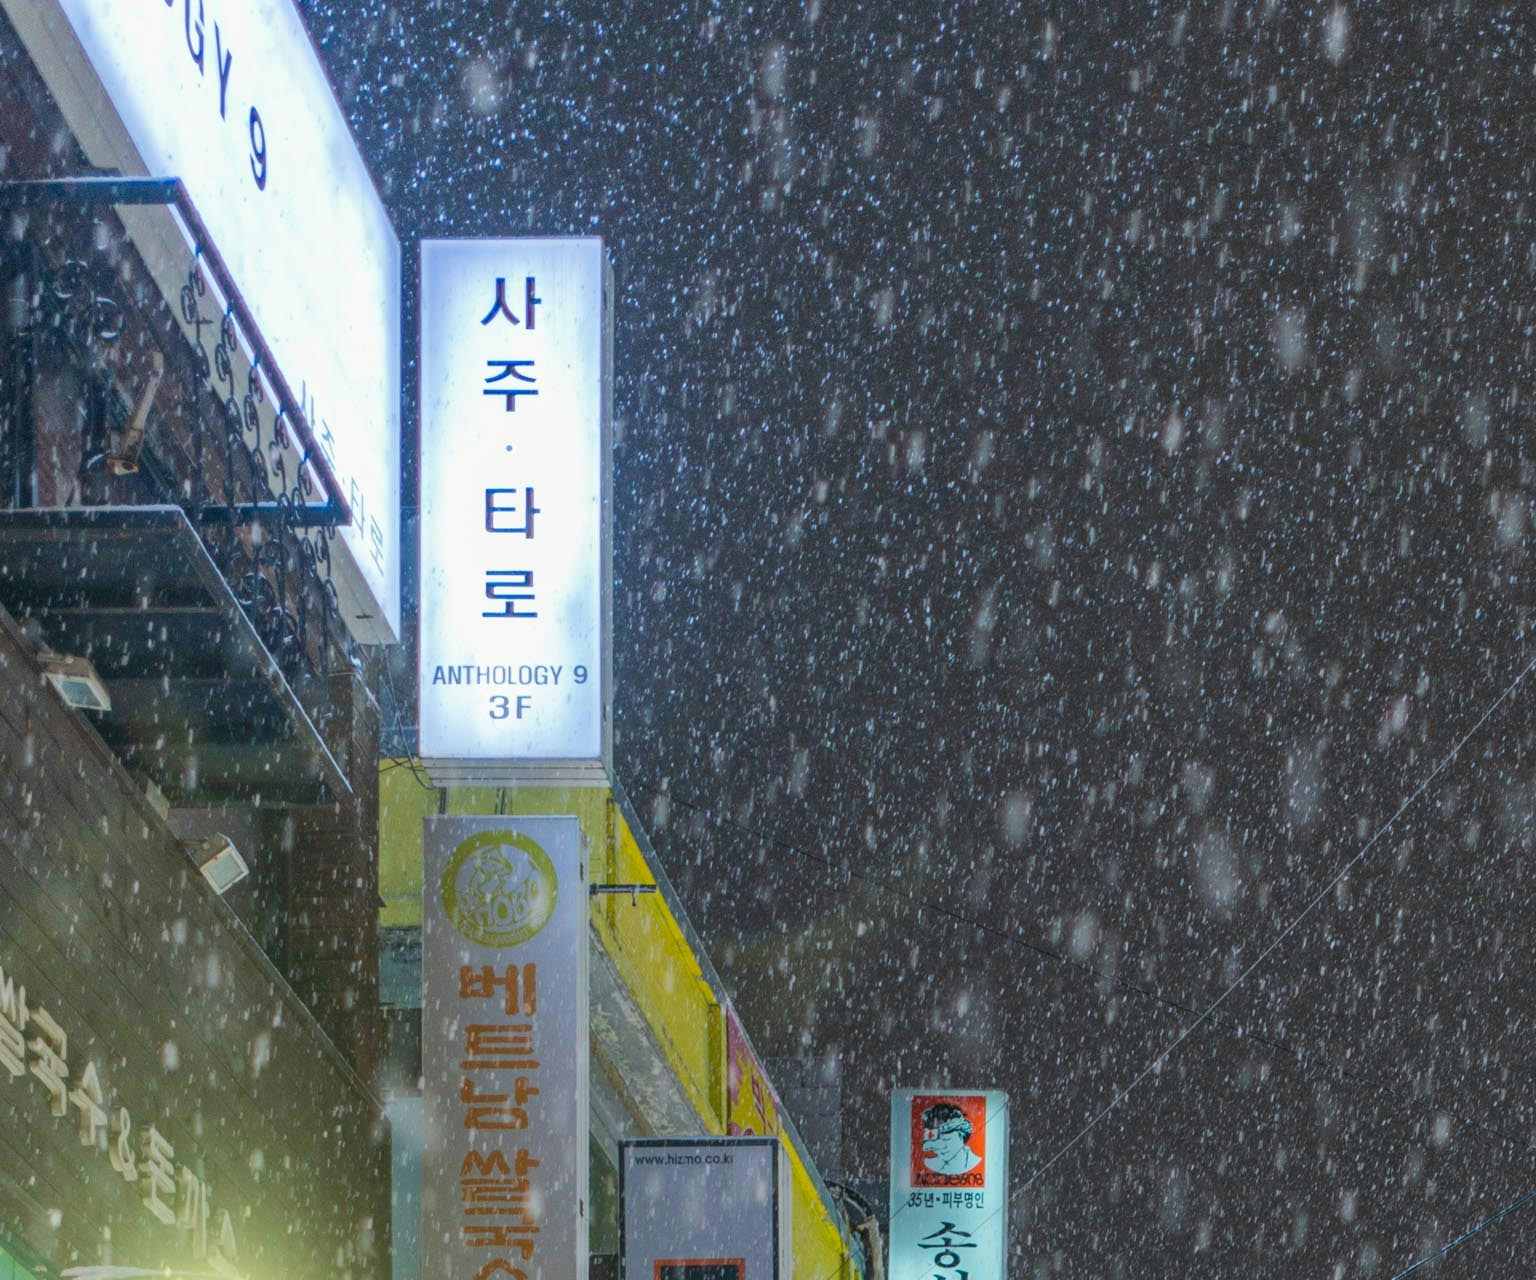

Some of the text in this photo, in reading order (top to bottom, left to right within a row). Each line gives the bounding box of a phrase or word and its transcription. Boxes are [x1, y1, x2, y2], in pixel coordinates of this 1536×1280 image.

[163, 0, 266, 191] GY 9
[432, 664, 588, 686] ANTHOLOGY 9
[488, 696, 532, 720] 3F
